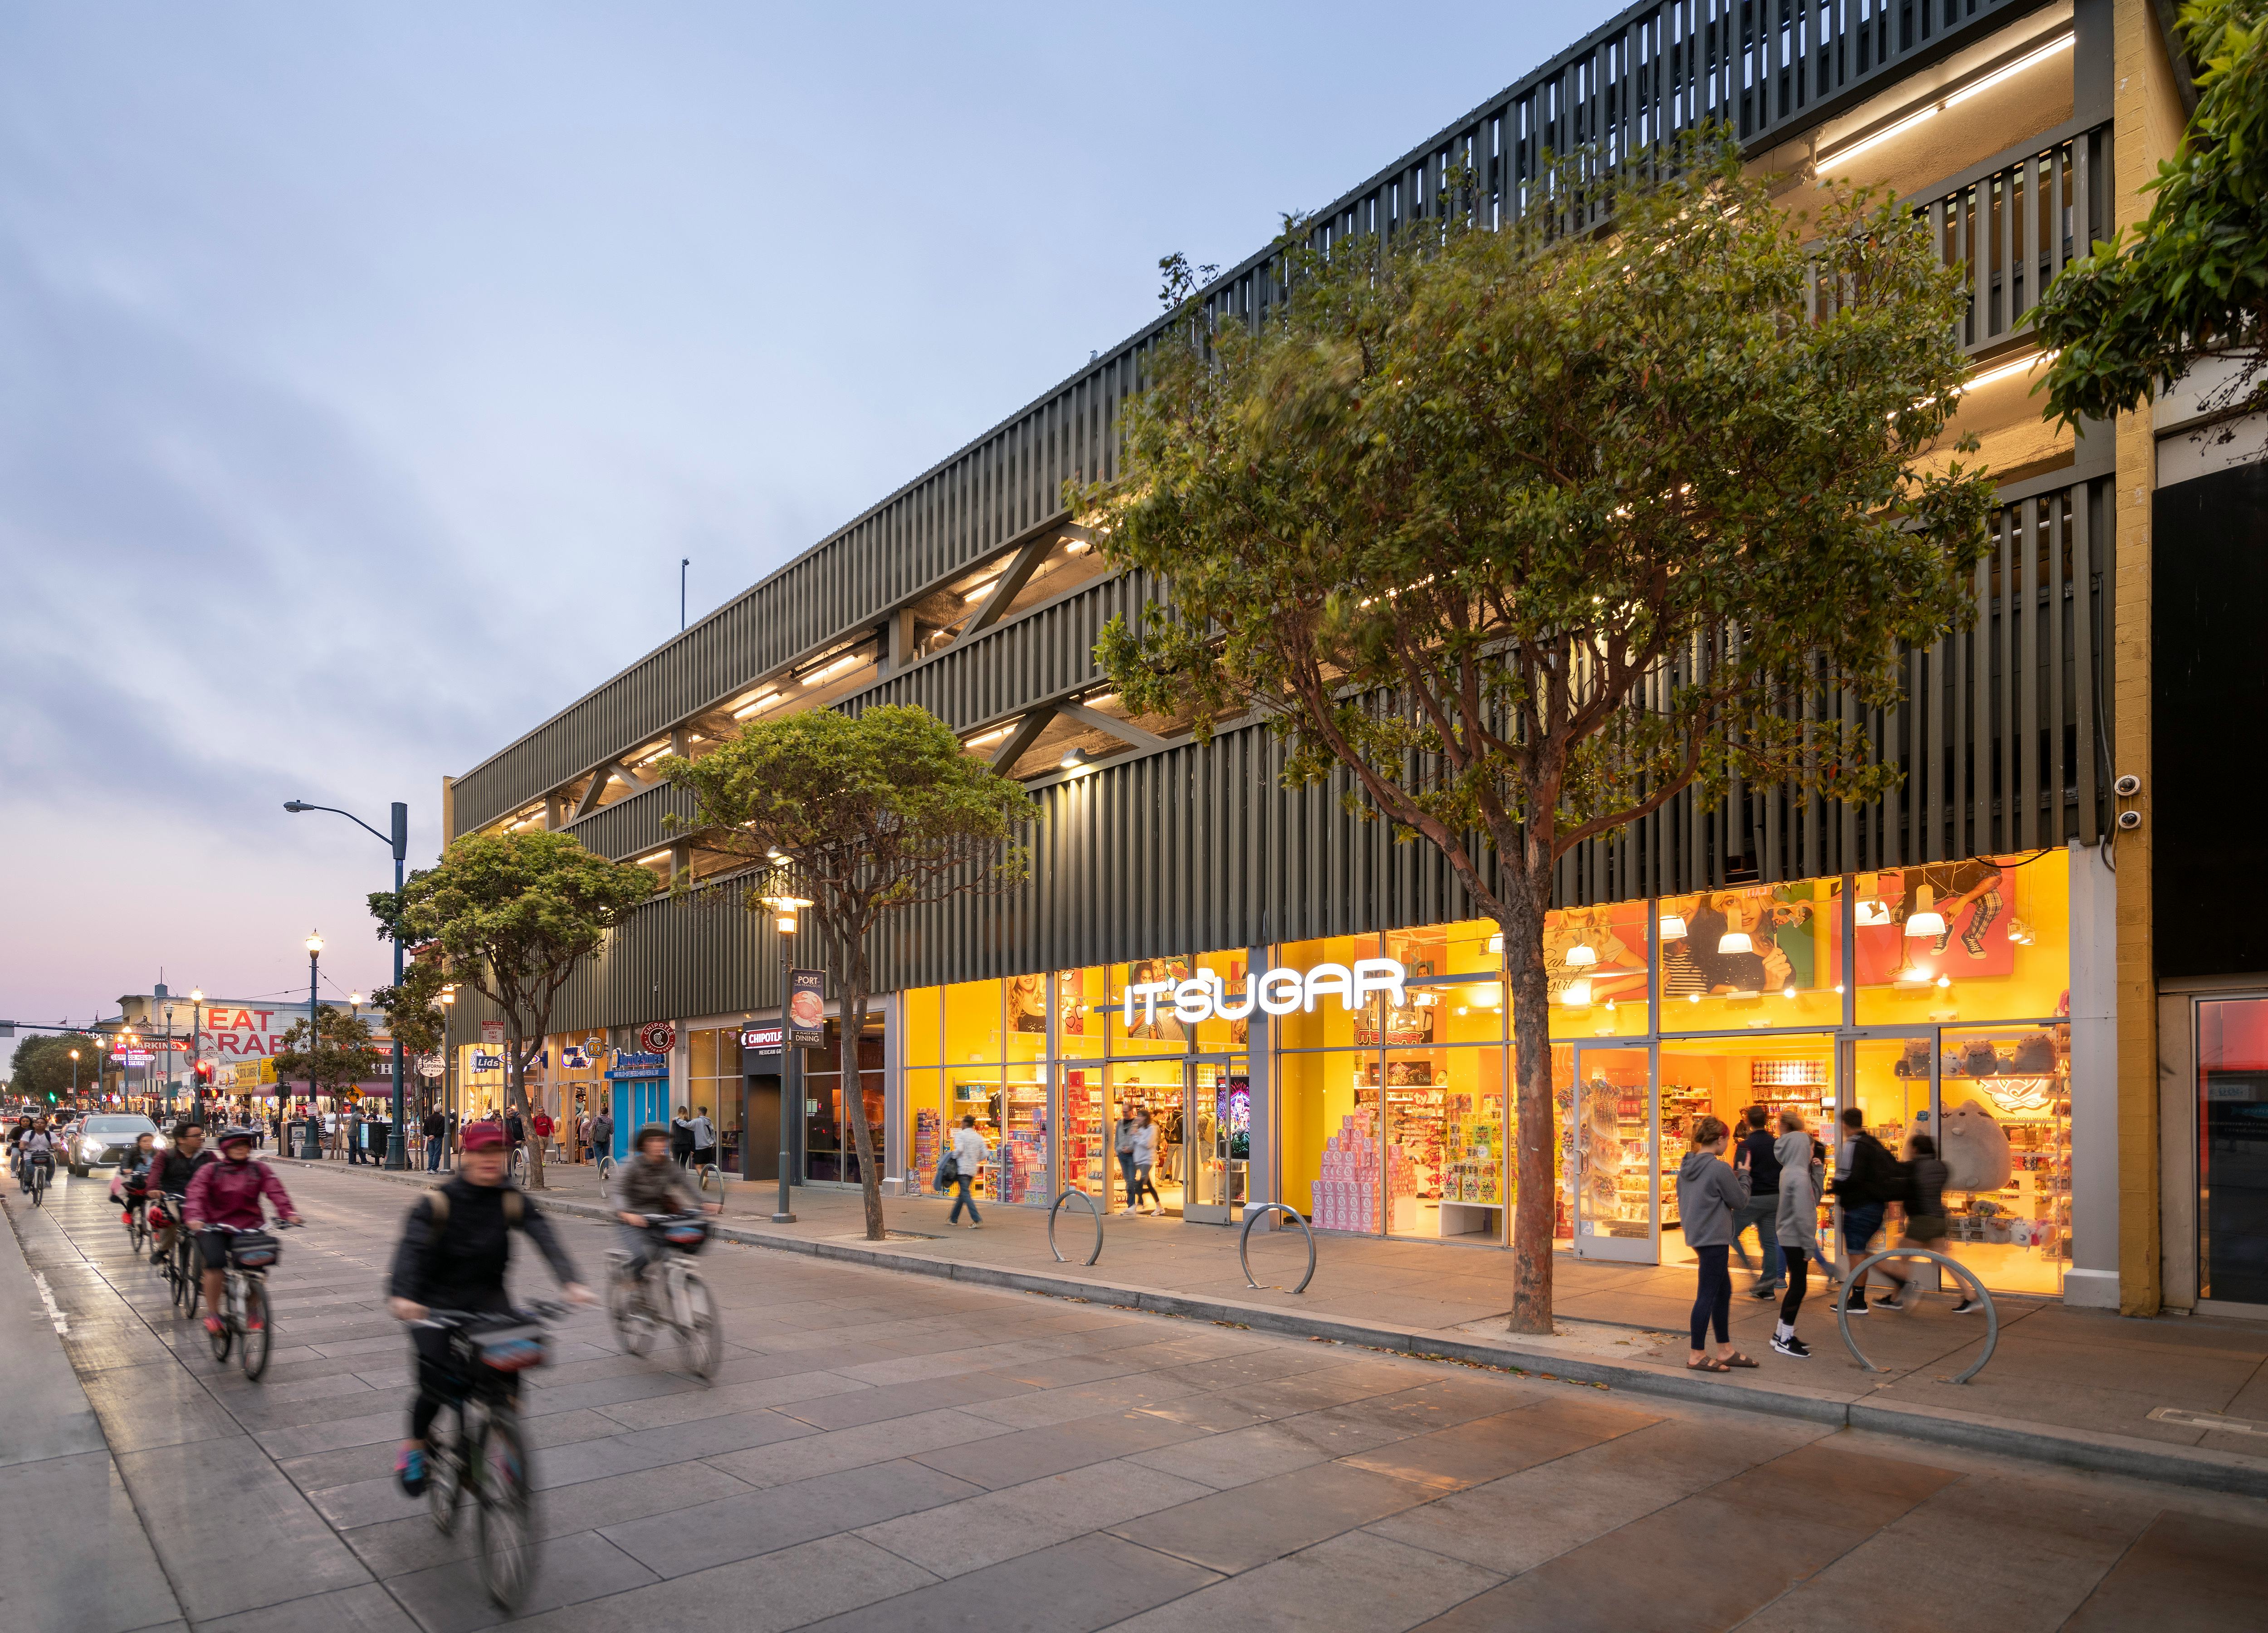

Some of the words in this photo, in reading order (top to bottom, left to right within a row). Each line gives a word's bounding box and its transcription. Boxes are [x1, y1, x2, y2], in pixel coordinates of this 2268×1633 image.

[798, 976, 818, 984] PORT
[1124, 958, 1405, 1027] IT'SUGAR
[209, 1009, 274, 1031] EAT
[644, 1023, 674, 1036] CHIPOTLE
[748, 1031, 782, 1044] CHIPOTLE
[1358, 1030, 1421, 1044] IT'SGAR
[191, 1032, 290, 1056] CRAB
[645, 1040, 662, 1052] MEXICAN
[663, 1041, 674, 1051] GRILL
[1414, 1092, 1427, 1105] ty
